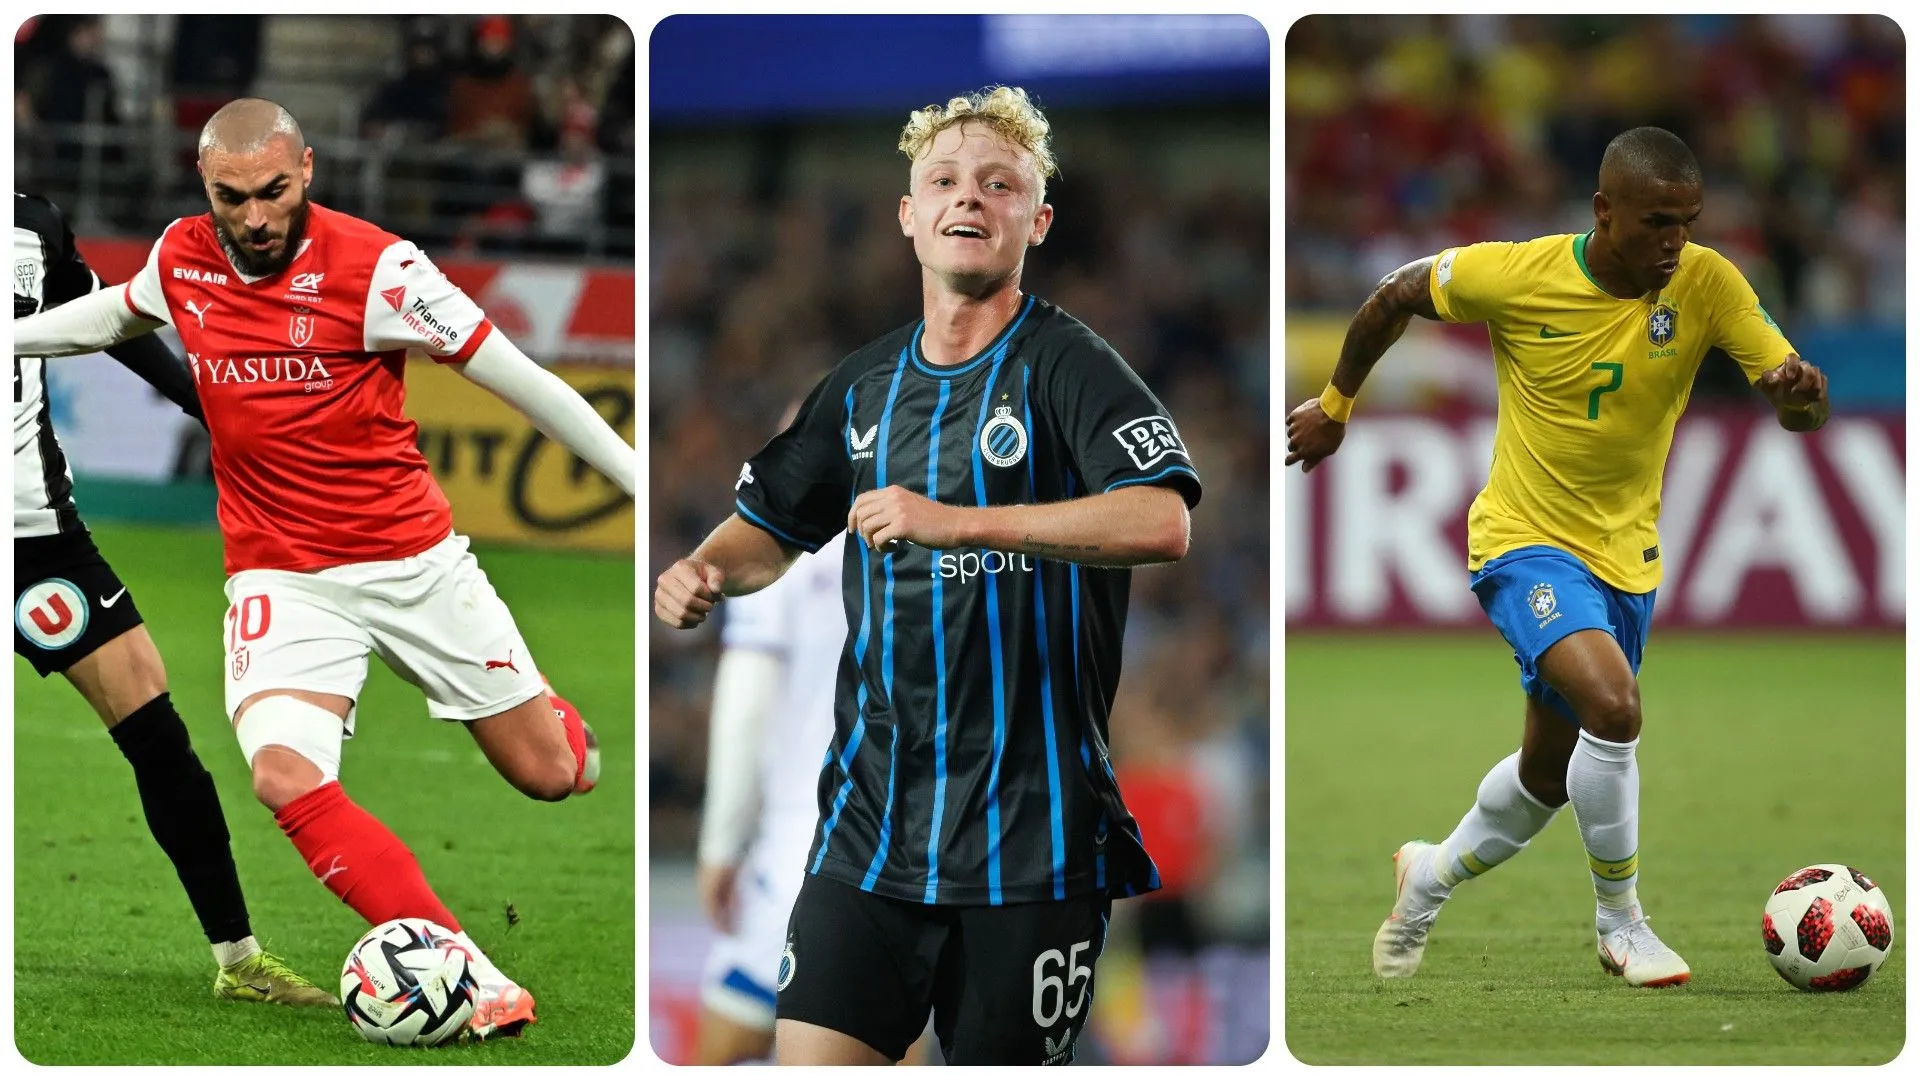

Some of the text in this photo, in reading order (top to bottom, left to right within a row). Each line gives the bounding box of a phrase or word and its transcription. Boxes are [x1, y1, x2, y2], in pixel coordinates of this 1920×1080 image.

[17, 263, 34, 277] SCO
[412, 296, 458, 341] Triangle
[205, 356, 332, 384] YASUDA
[1648, 348, 1678, 360] BRASIL
[304, 379, 334, 393] group
[1588, 362, 1624, 421] 7
[28, 592, 73, 636] U
[228, 593, 272, 653] 10
[1032, 940, 1092, 1028] 65
